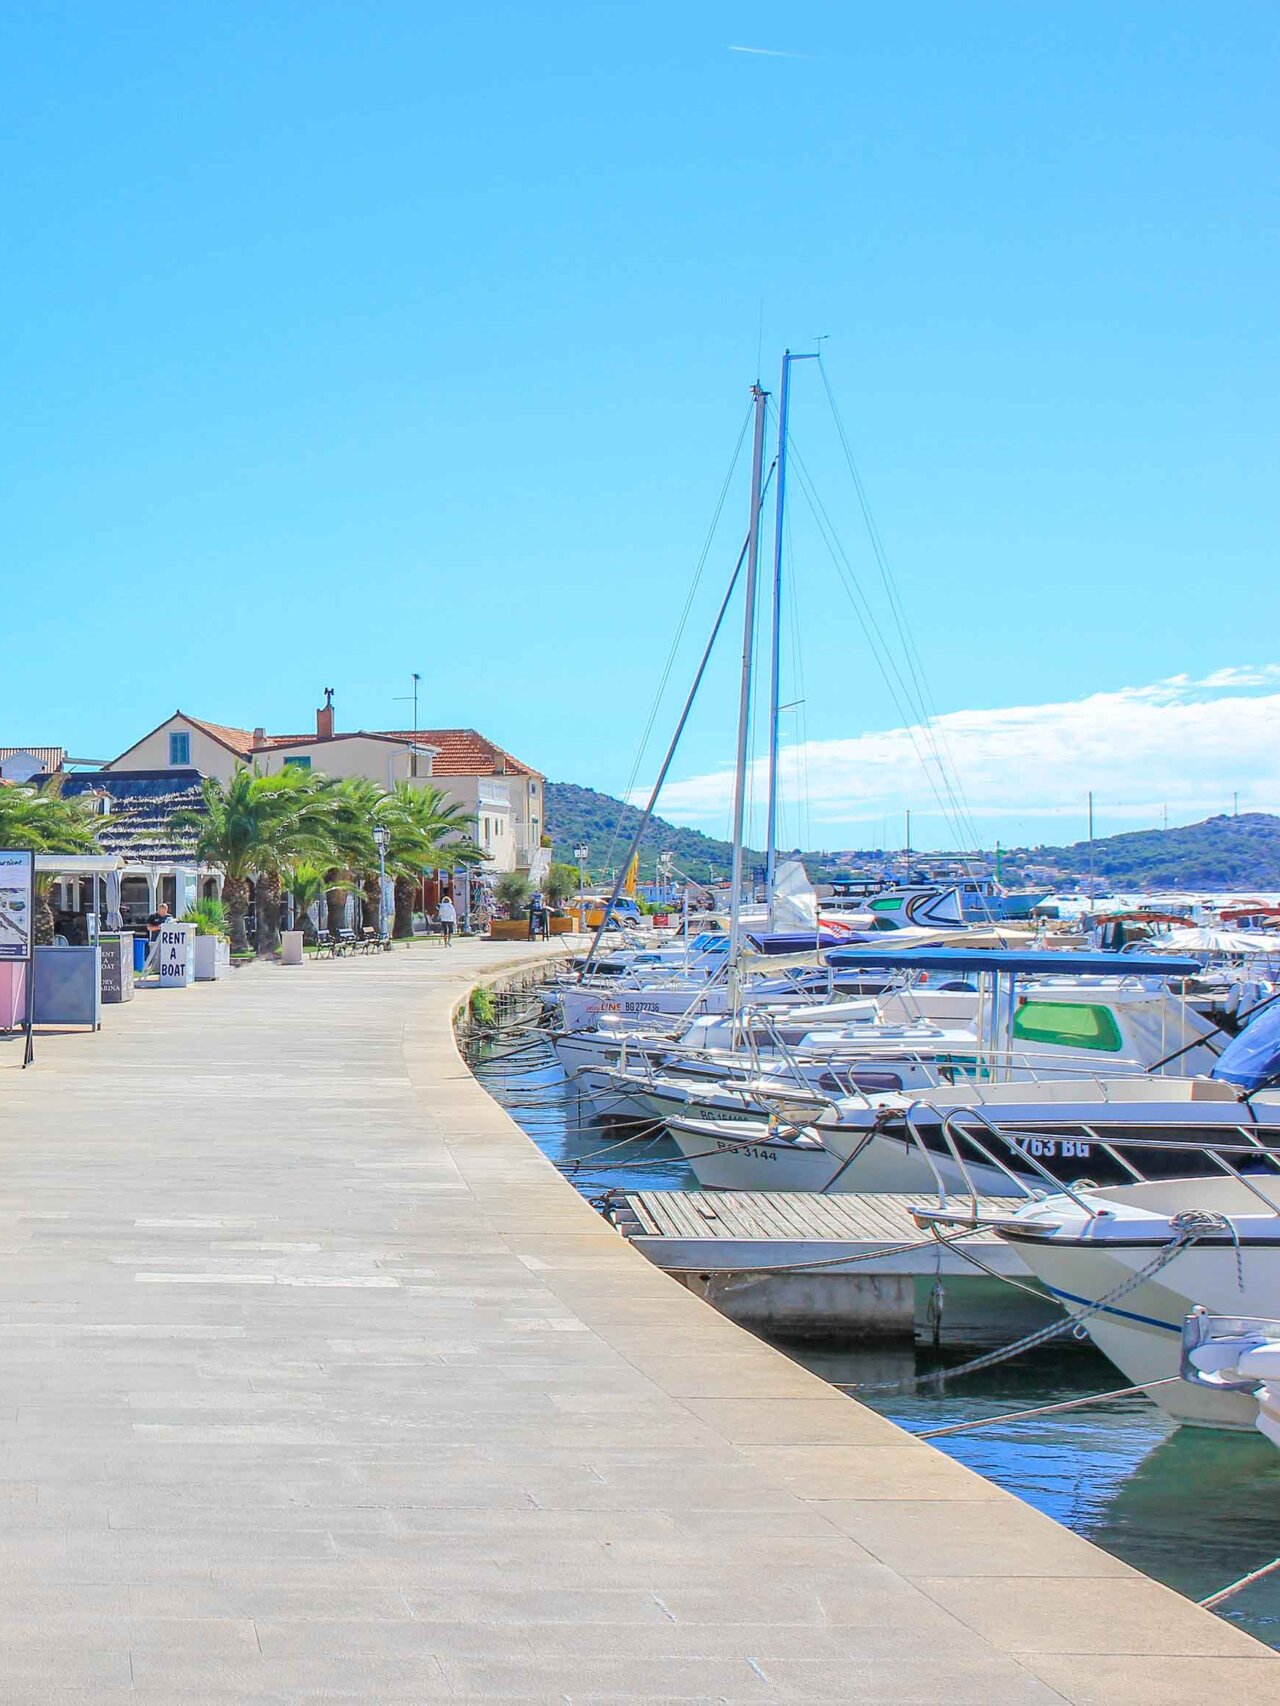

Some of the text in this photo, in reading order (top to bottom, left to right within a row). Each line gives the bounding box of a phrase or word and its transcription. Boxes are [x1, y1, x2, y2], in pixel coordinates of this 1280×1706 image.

[162, 932, 186, 945] RENT
[170, 947, 176, 960] A
[161, 964, 185, 977] BOAT
[700, 1110, 715, 1120] BG
[743, 1146, 777, 1161] 3144
[1062, 1140, 1090, 1157] BG
